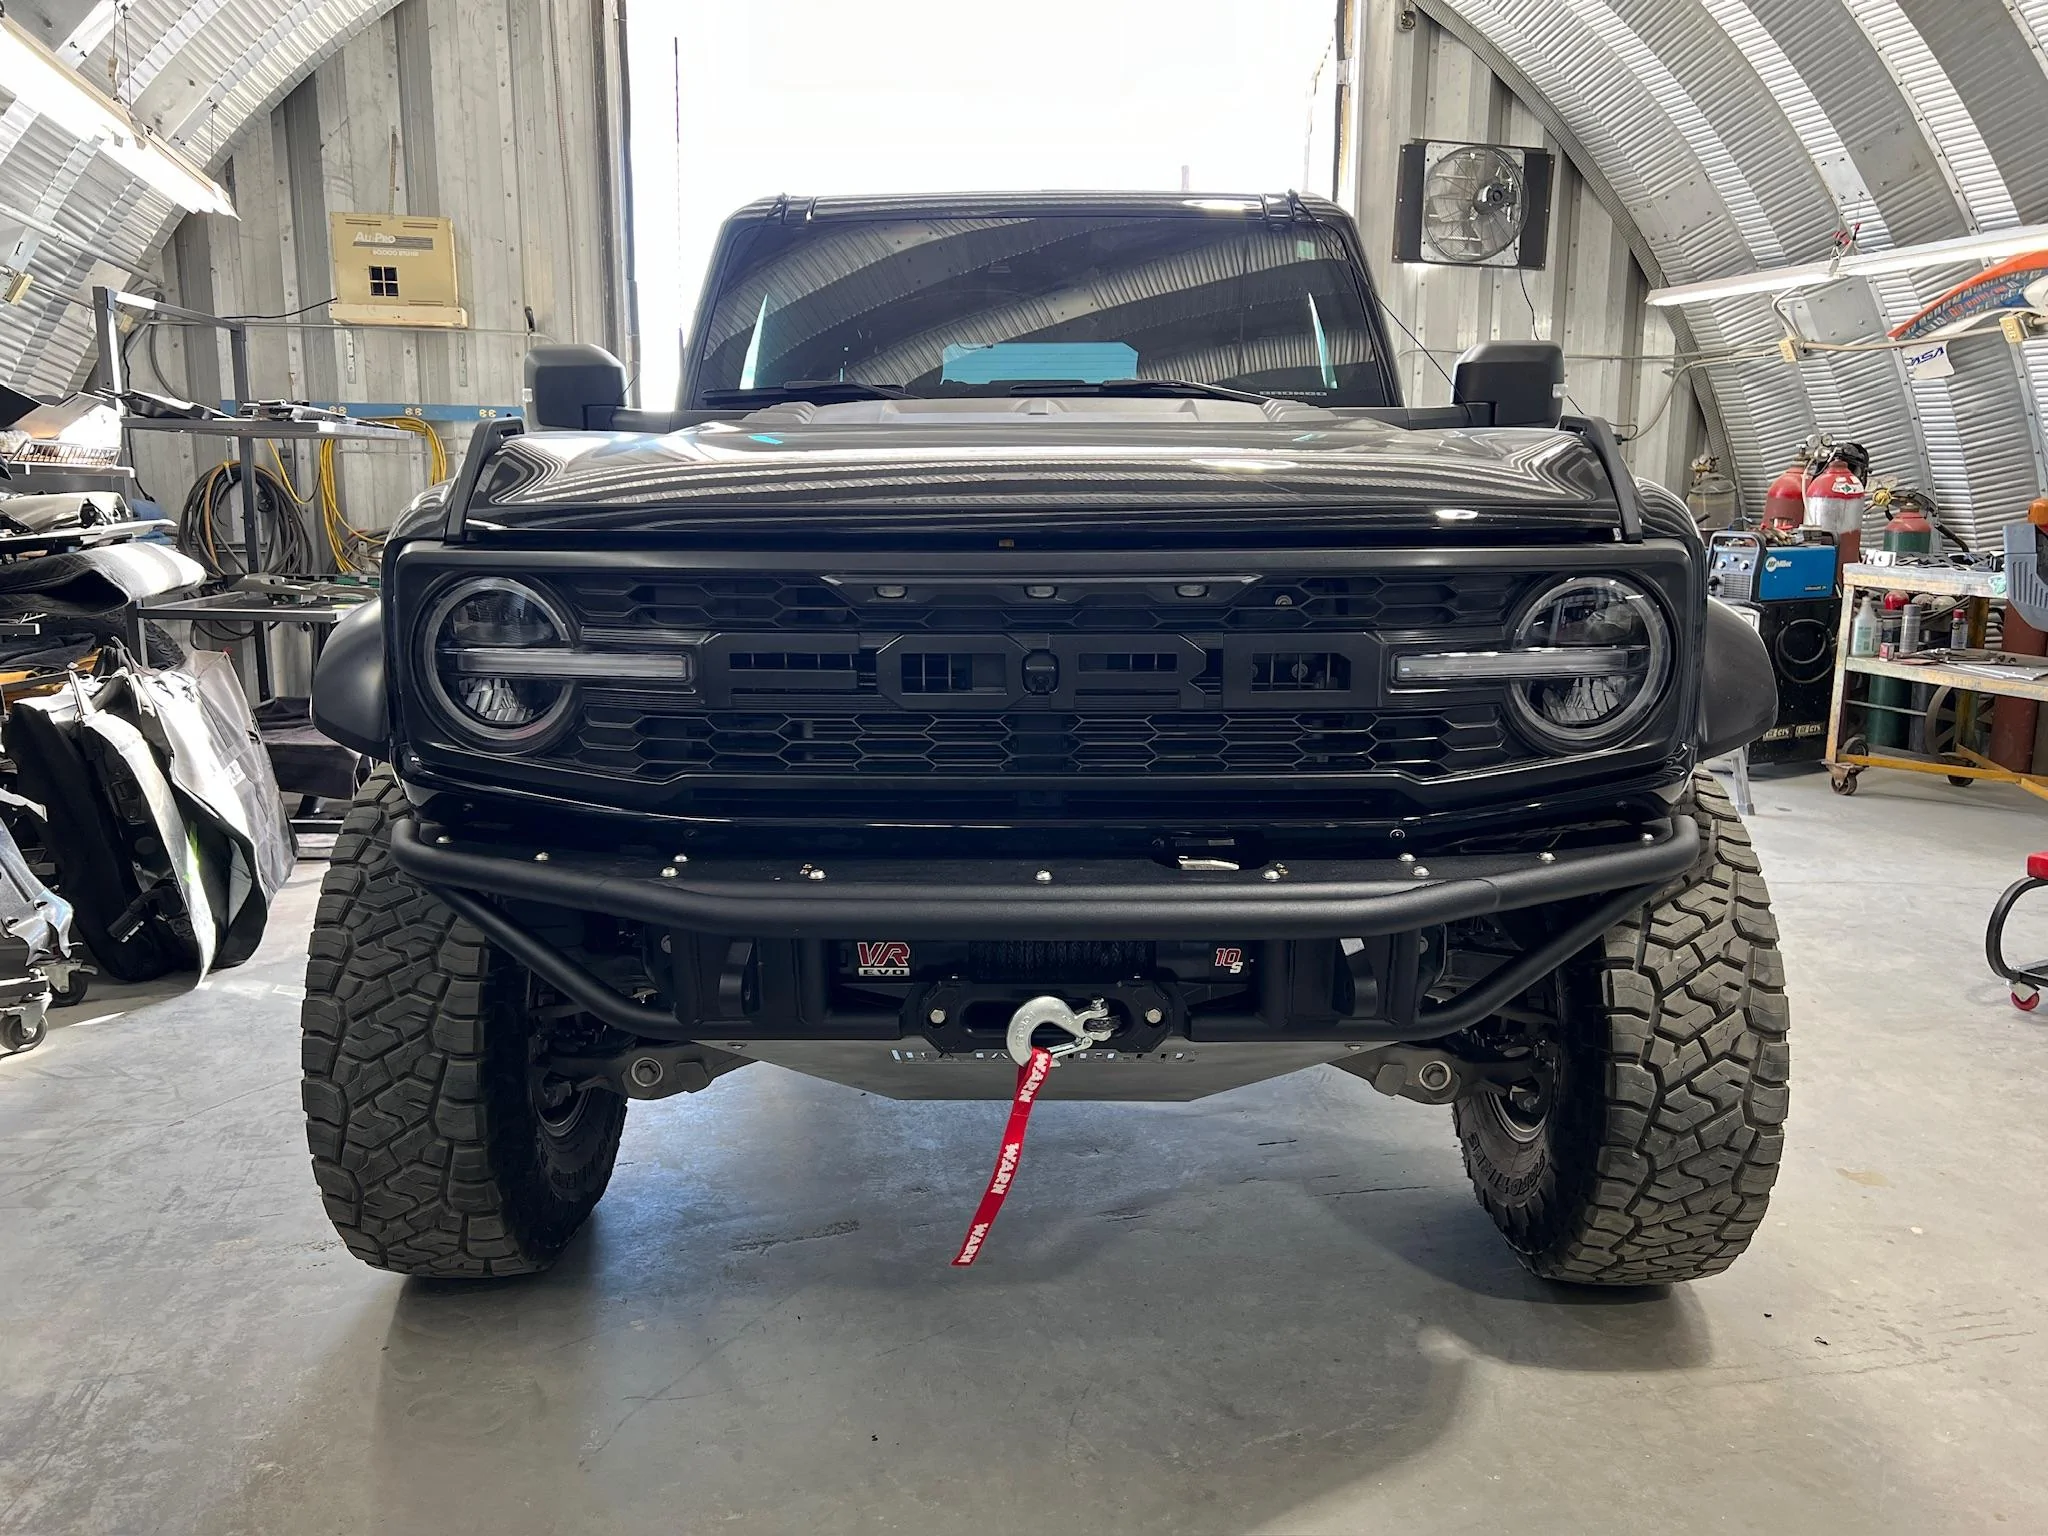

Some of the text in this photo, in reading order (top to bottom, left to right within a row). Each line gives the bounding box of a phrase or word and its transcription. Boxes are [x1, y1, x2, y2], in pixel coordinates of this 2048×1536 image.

[701, 632, 1379, 709] FORD
[857, 942, 911, 967] VR
[861, 968, 907, 976] EVO
[1018, 1052, 1049, 1103] WARN
[990, 1142, 1020, 1195] WARN
[957, 1222, 989, 1263] WARN
